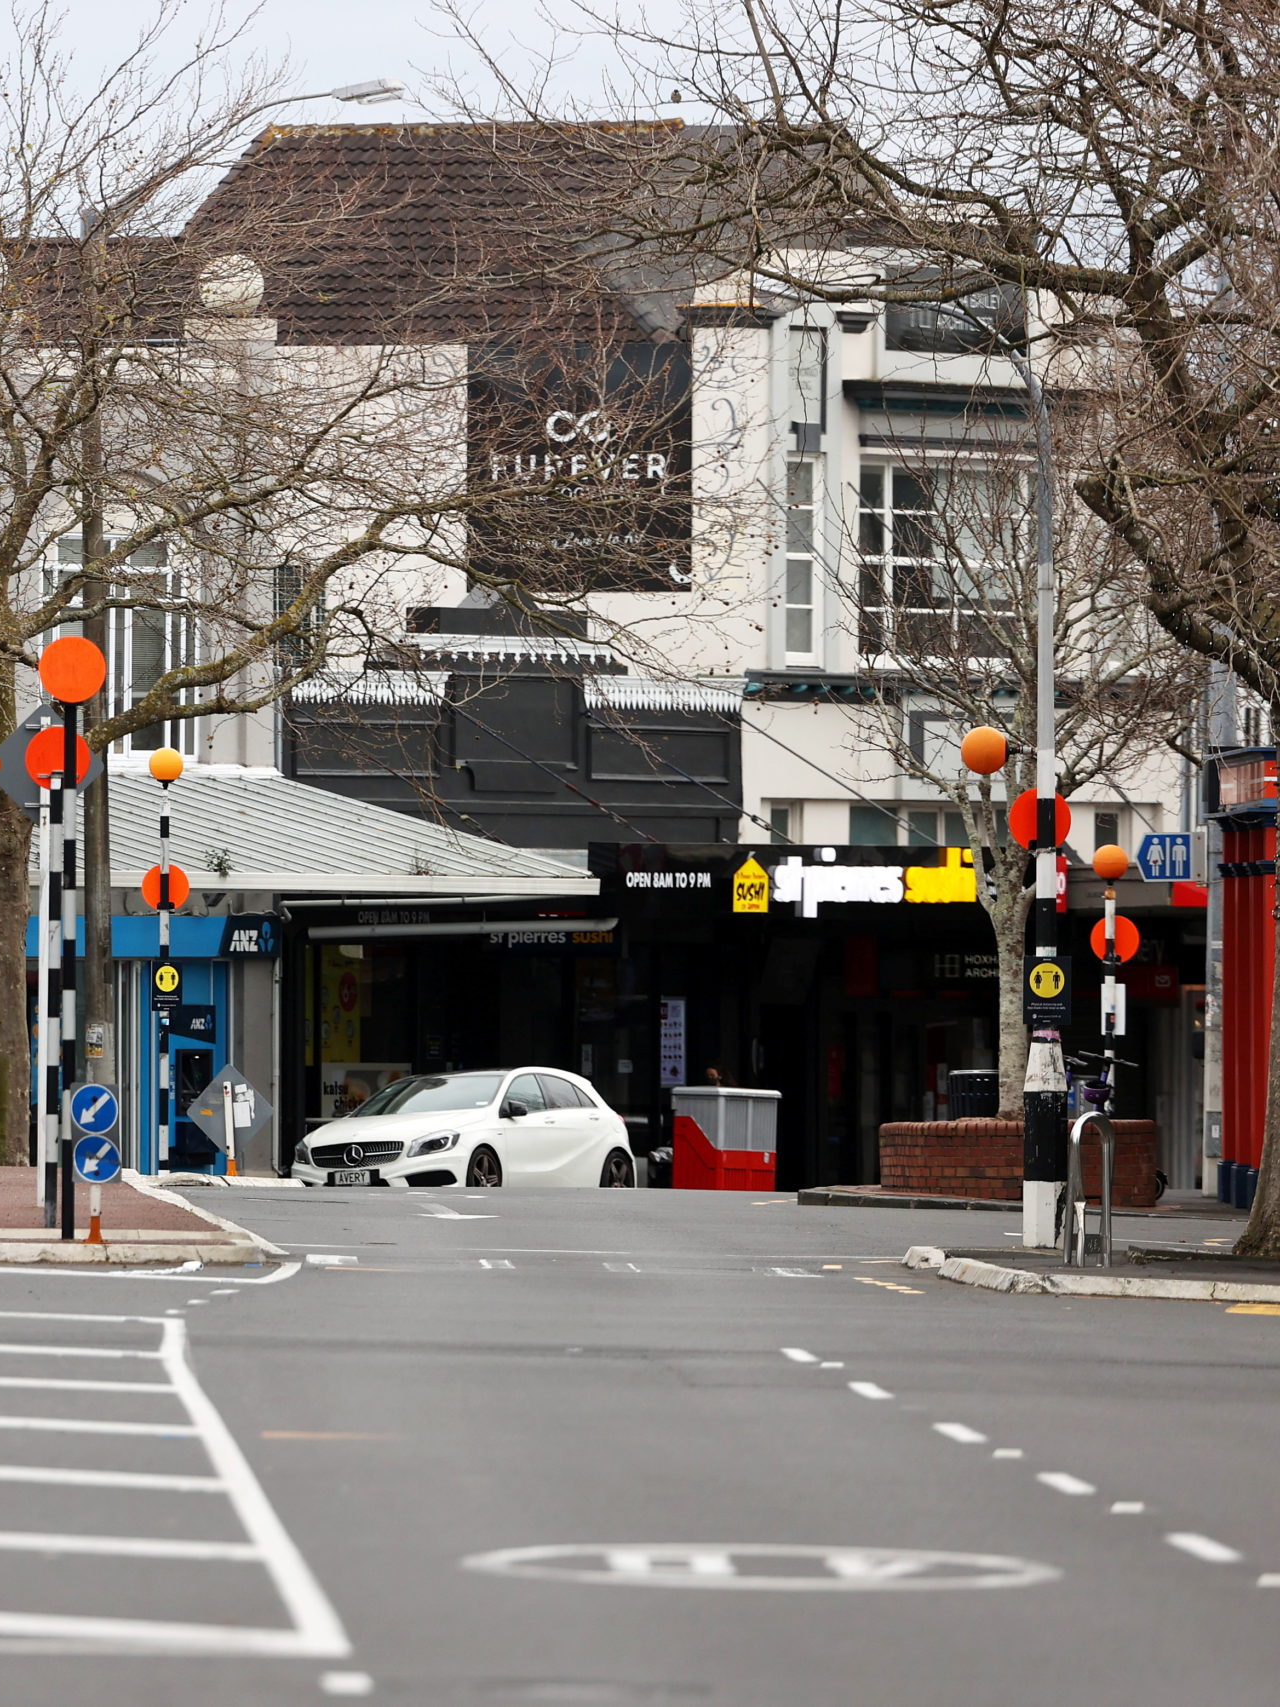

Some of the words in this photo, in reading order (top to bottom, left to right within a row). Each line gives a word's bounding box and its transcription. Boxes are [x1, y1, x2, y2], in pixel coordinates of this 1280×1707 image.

[625, 872, 651, 888] OPEN
[652, 872, 674, 888] 8AM
[675, 872, 688, 888] TO
[689, 872, 696, 888] 9
[697, 872, 712, 888] PM
[736, 882, 765, 901] SUSHI
[229, 930, 258, 952] ANZ
[507, 932, 567, 948] pierres
[571, 932, 614, 944] sushi
[964, 954, 999, 964] HOXH
[191, 1018, 205, 1030] ANZ
[323, 1080, 350, 1096] katsu
[339, 1171, 366, 1184] AVERY
